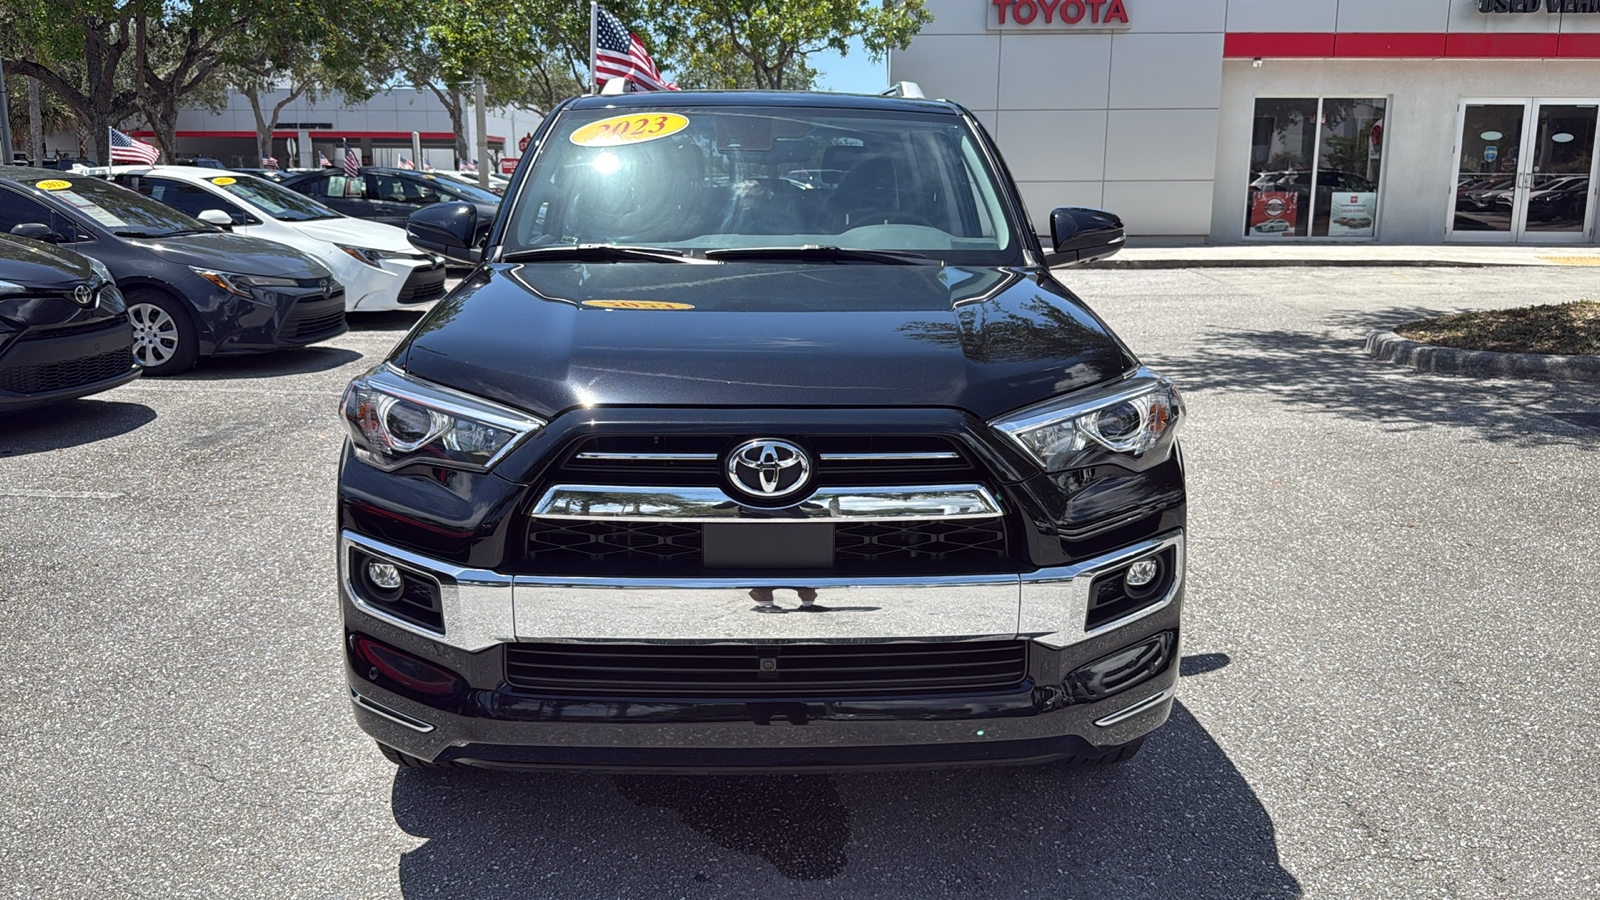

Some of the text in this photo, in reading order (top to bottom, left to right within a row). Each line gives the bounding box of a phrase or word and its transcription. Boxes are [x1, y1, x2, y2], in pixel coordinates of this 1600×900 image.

[992, 0, 1129, 25] TOYOTA
[1478, 0, 1600, 13] USED VEHI
[584, 116, 668, 143] 2023
